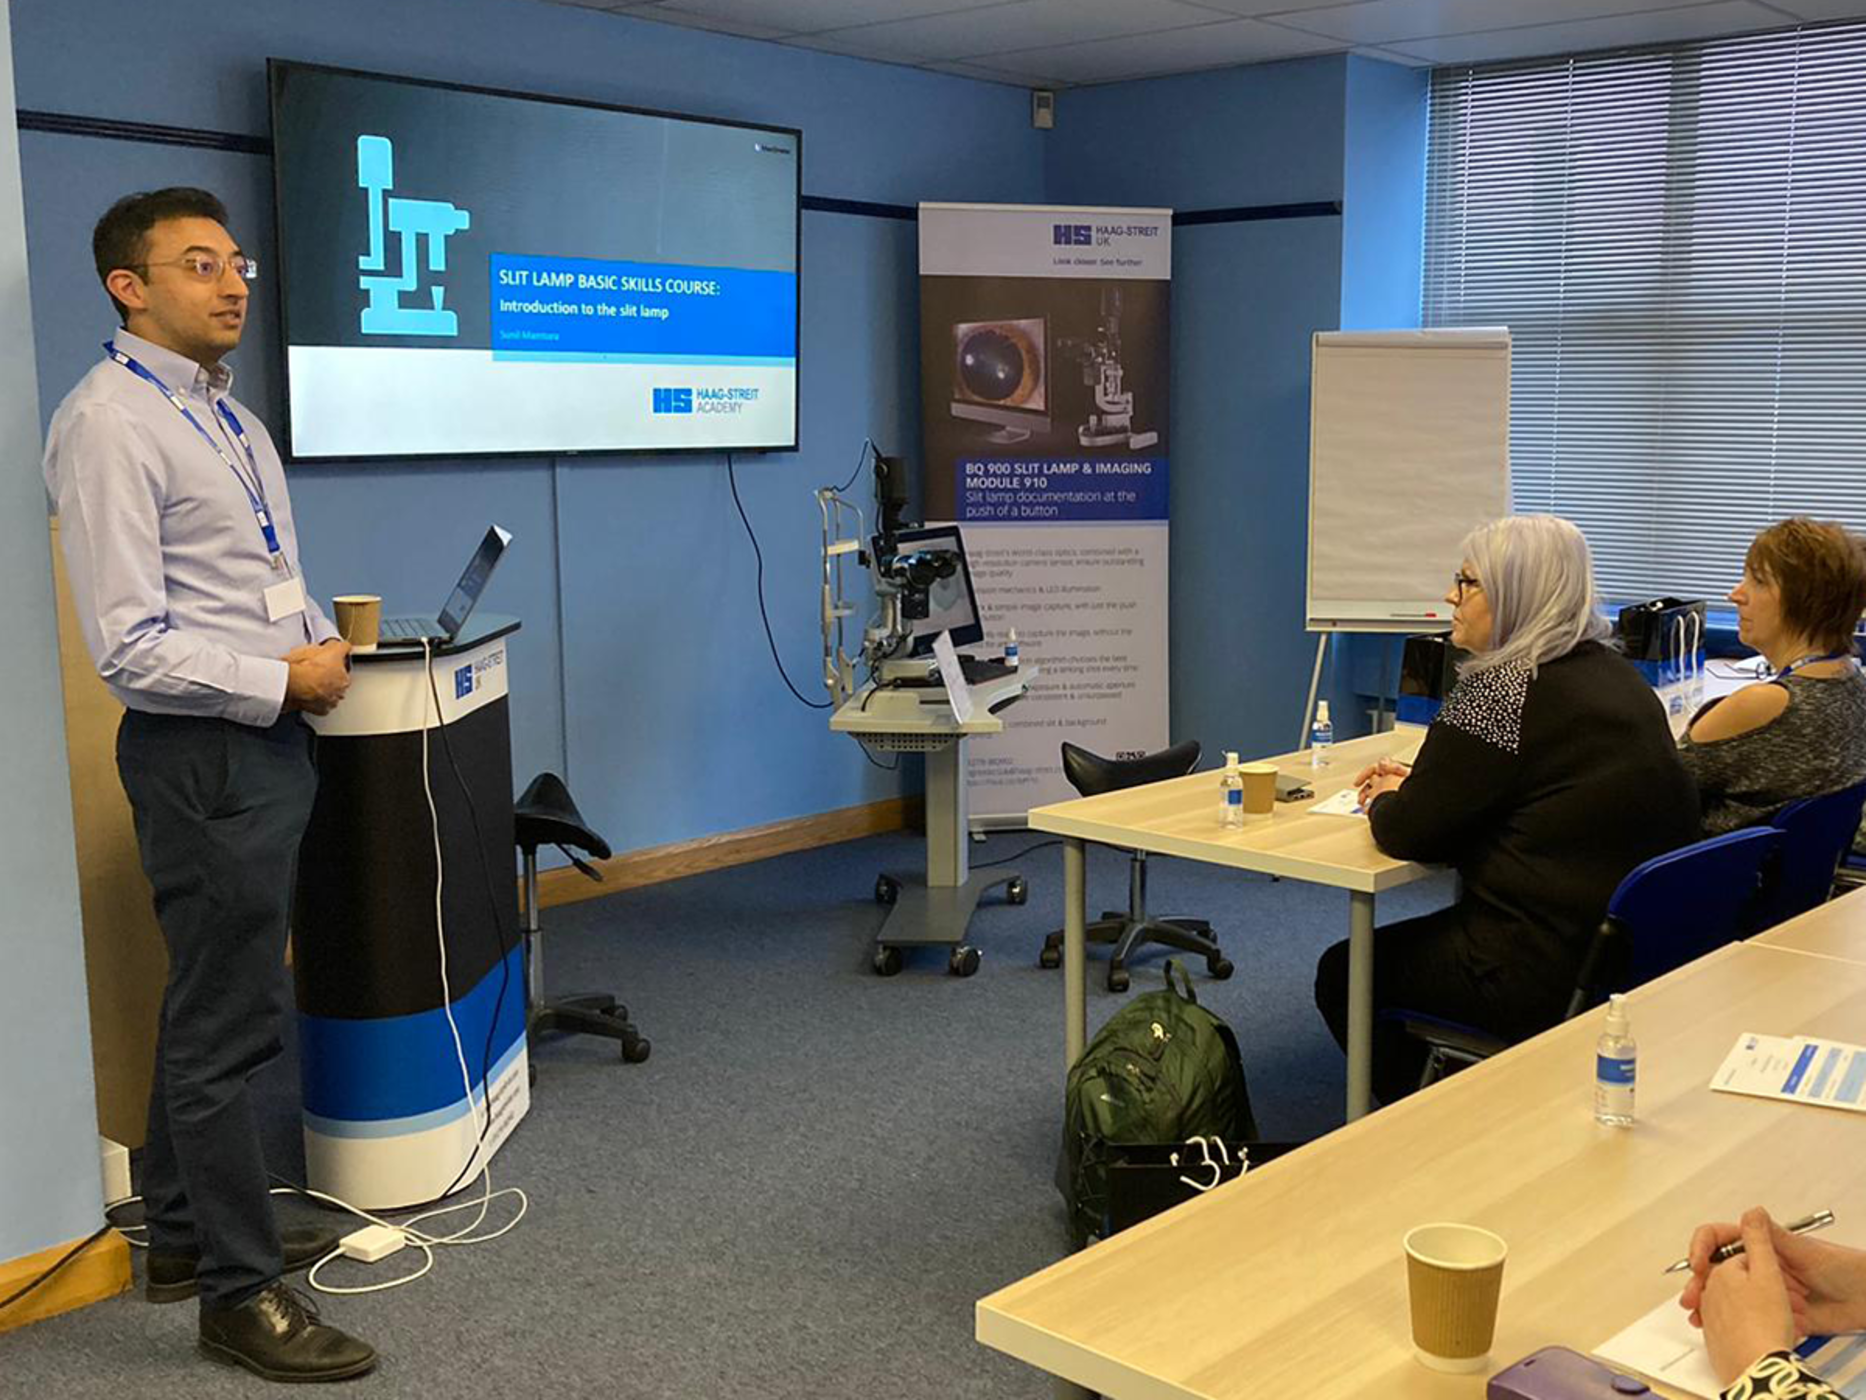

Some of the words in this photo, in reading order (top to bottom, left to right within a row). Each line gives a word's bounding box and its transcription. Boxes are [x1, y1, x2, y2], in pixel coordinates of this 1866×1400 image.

[1096, 226, 1159, 236] HAAG-STREIT
[1096, 237, 1111, 246] UK
[499, 269, 529, 286] SLIT
[532, 271, 575, 288] LAMP
[578, 273, 618, 290] BASIC
[621, 275, 663, 292] SKILLS
[665, 278, 721, 295] COURSE:
[500, 299, 578, 315] Introduction
[581, 302, 594, 315] to
[597, 303, 617, 317] the
[619, 304, 637, 317] slit
[640, 304, 670, 321] lamp
[653, 388, 692, 413] HS
[696, 388, 759, 400] HAAG-STREIT
[696, 401, 743, 413] ACADEMY
[965, 463, 984, 476] BQ
[987, 463, 1011, 475] 900
[1014, 463, 1040, 474] SLIT
[1043, 463, 1079, 474] LAMP
[1082, 463, 1092, 474] &
[1095, 463, 1152, 474] IMAGING
[966, 477, 1020, 489] MODULE
[1024, 477, 1048, 488] 910
[966, 491, 984, 503] Slit
[985, 491, 1014, 504] lamp
[1016, 491, 1101, 503] documentation
[1103, 492, 1115, 502] at
[1117, 491, 1136, 502] the
[966, 505, 995, 518] push
[997, 504, 1009, 516] of
[1011, 507, 1018, 516] a
[1021, 504, 1058, 517] button
